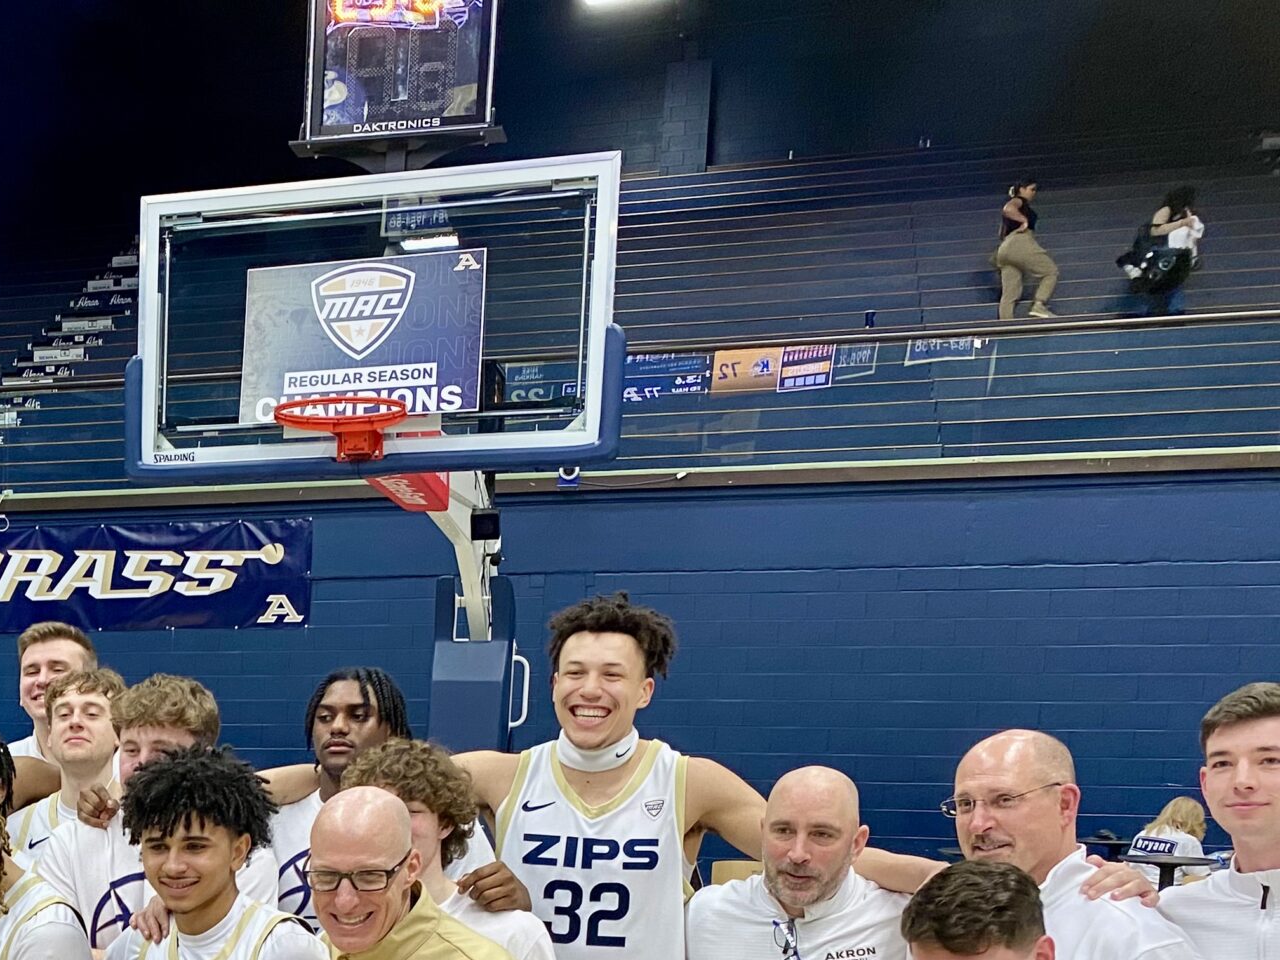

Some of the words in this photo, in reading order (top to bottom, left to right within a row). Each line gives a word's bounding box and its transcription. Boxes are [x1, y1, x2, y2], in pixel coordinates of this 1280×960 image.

[353, 117, 441, 133] DAKTRONICS
[453, 253, 482, 271] A
[321, 292, 405, 319] MAC
[288, 372, 363, 388] REGULAR
[367, 366, 434, 382] SEASON
[153, 451, 195, 463] SPALDING
[256, 594, 304, 623] A
[522, 833, 659, 870] ZIPS
[1136, 838, 1171, 853] bryant
[543, 880, 630, 947] 32
[824, 947, 876, 960] AKRON
